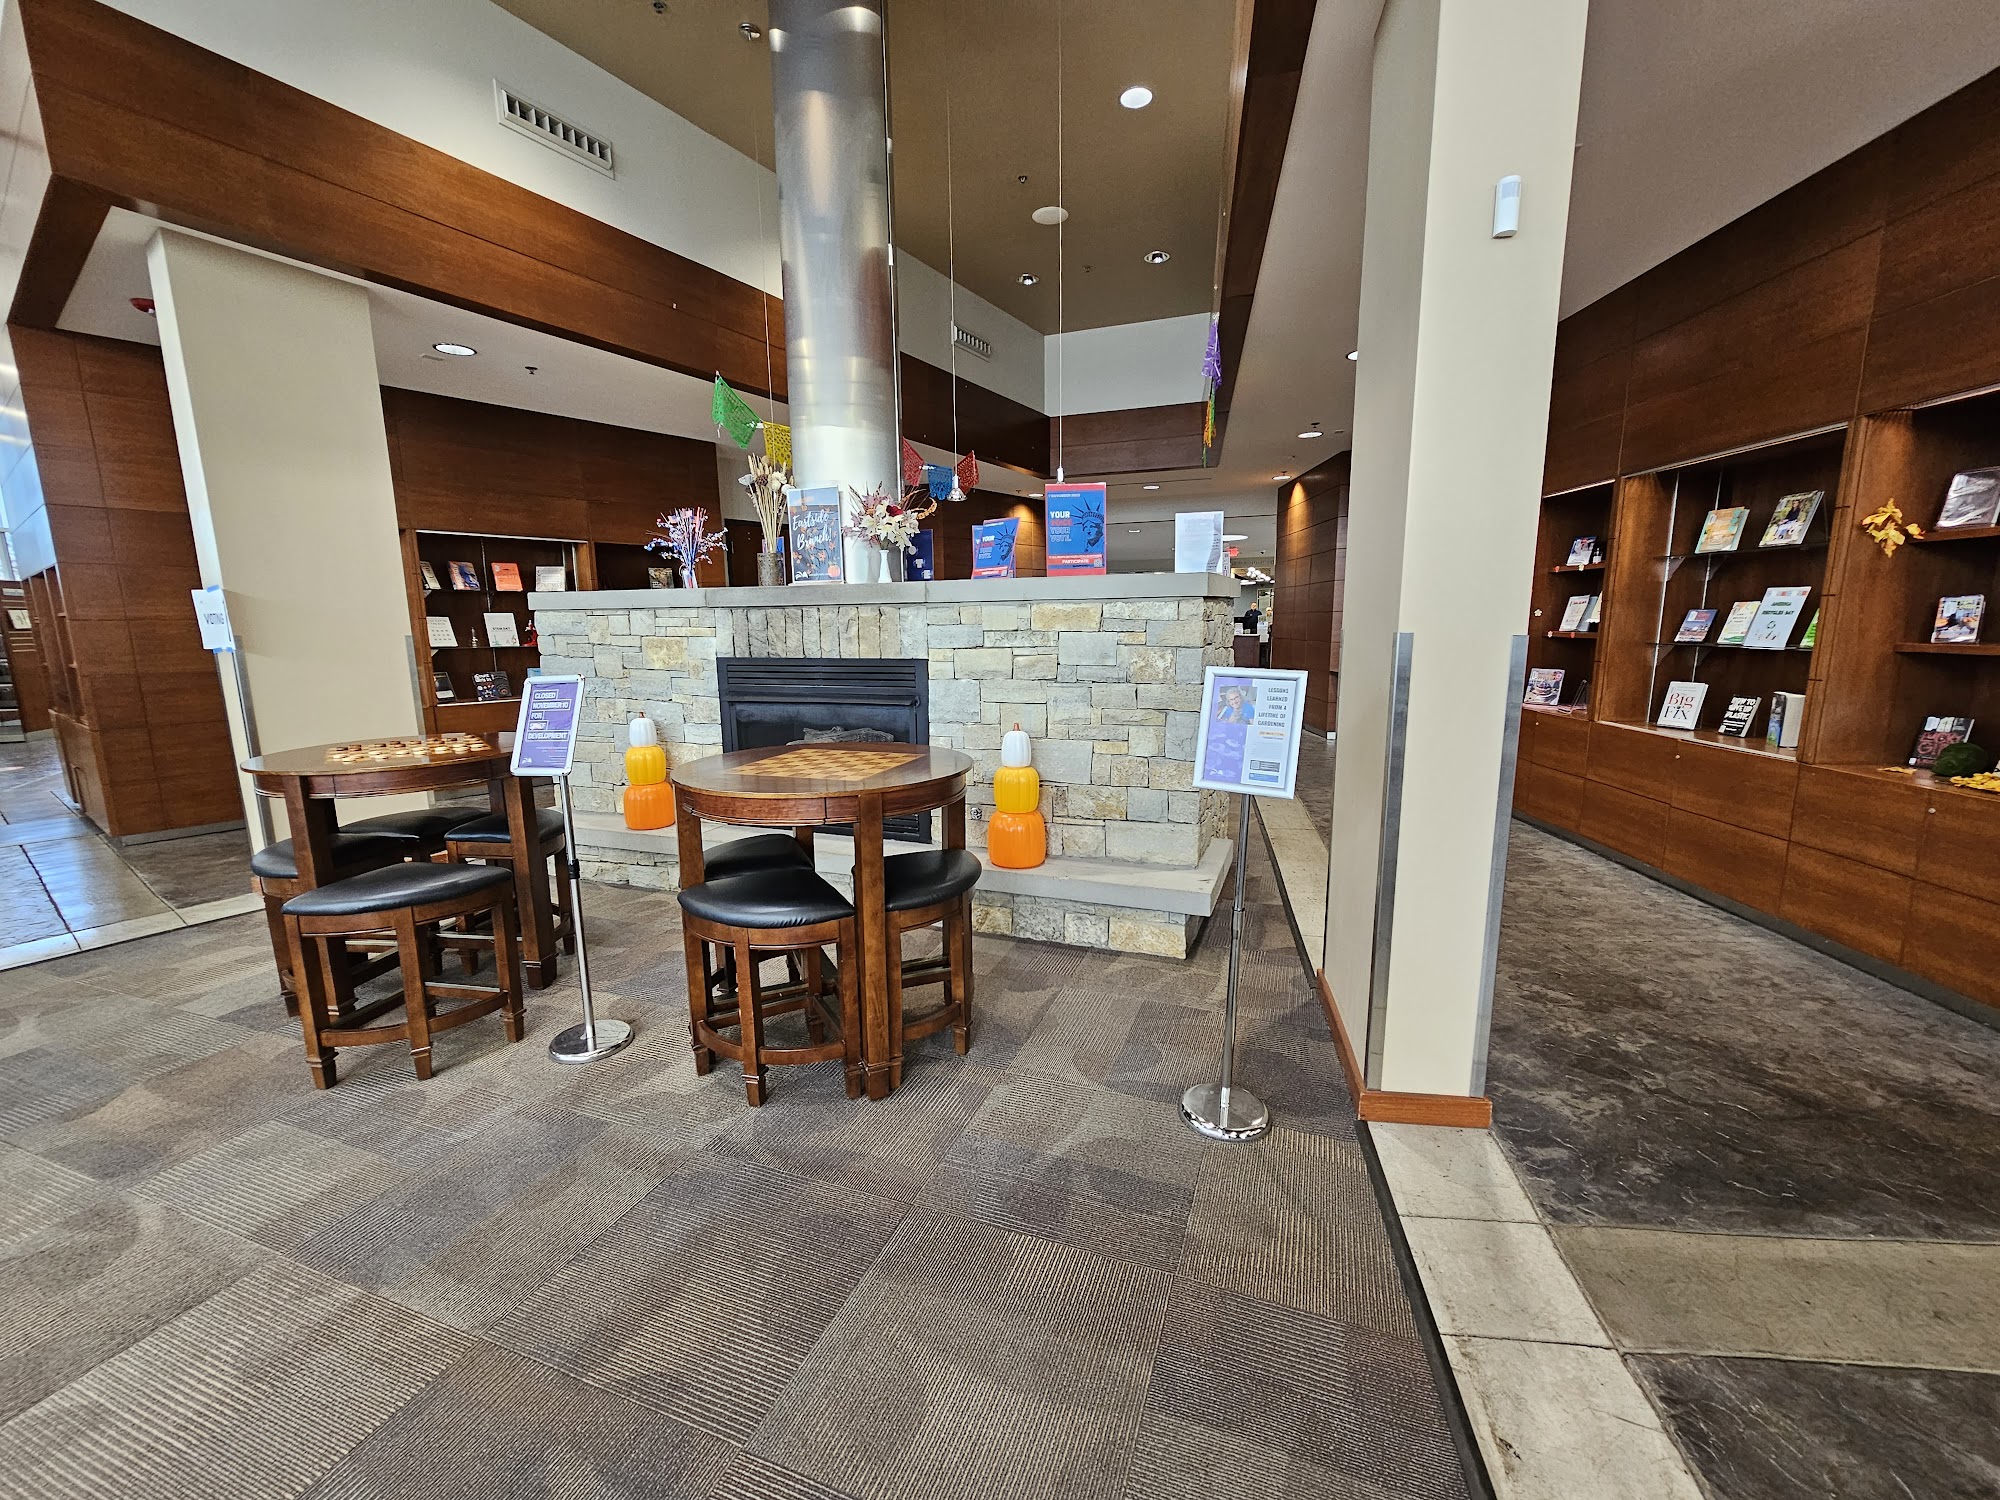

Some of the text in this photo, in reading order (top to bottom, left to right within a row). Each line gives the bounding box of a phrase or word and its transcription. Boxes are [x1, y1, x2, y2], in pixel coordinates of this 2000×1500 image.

[1050, 511, 1070, 519] YOUR
[792, 508, 830, 531] Eastside
[797, 524, 832, 550] Branch!
[203, 613, 225, 625] VOTING
[562, 701, 569, 709] 10
[1668, 693, 1695, 709] Big
[1746, 698, 1756, 706] TO
[531, 712, 542, 720] FOR
[1257, 720, 1286, 728] GARDENING
[527, 732, 568, 740] DEVELOPMENT
